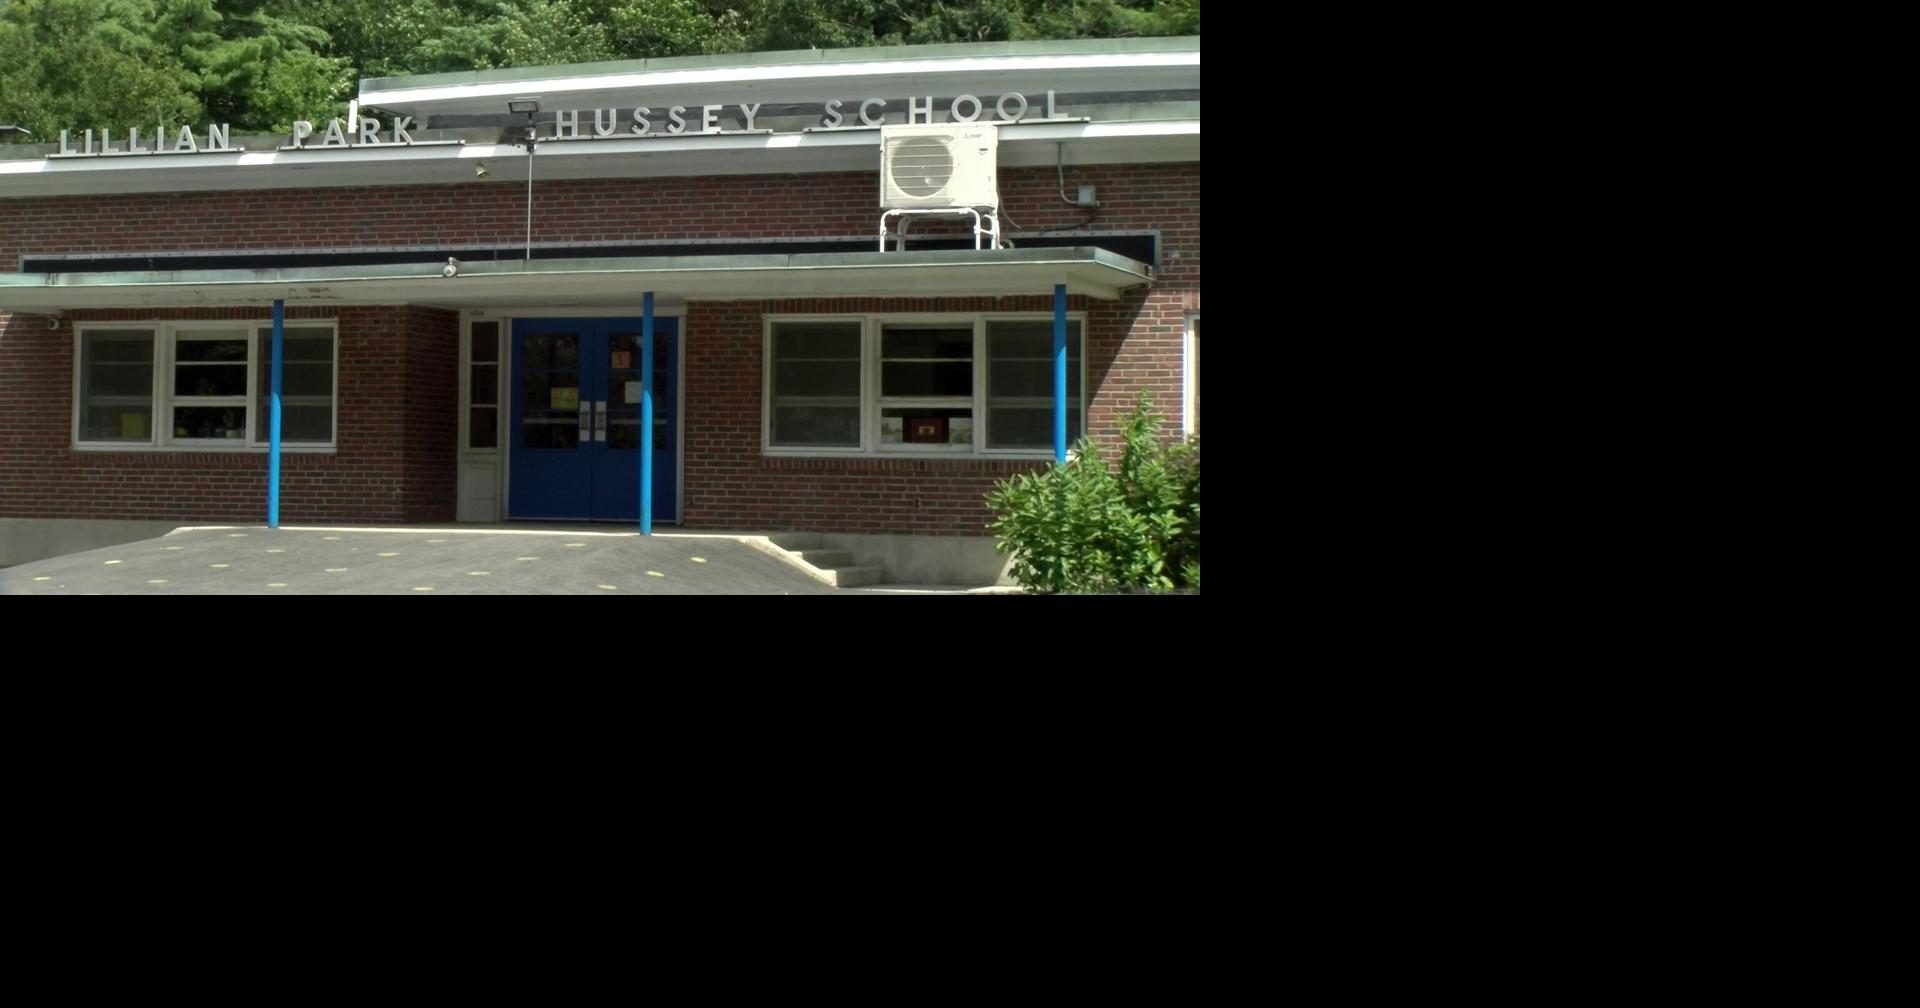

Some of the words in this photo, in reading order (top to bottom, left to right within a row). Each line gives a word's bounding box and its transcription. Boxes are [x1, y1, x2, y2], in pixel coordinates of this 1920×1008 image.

[60, 123, 230, 155] LILLIAN
[293, 116, 415, 147] PARK
[556, 103, 761, 137] HUSSEY
[823, 90, 1068, 128] SCHOOL
